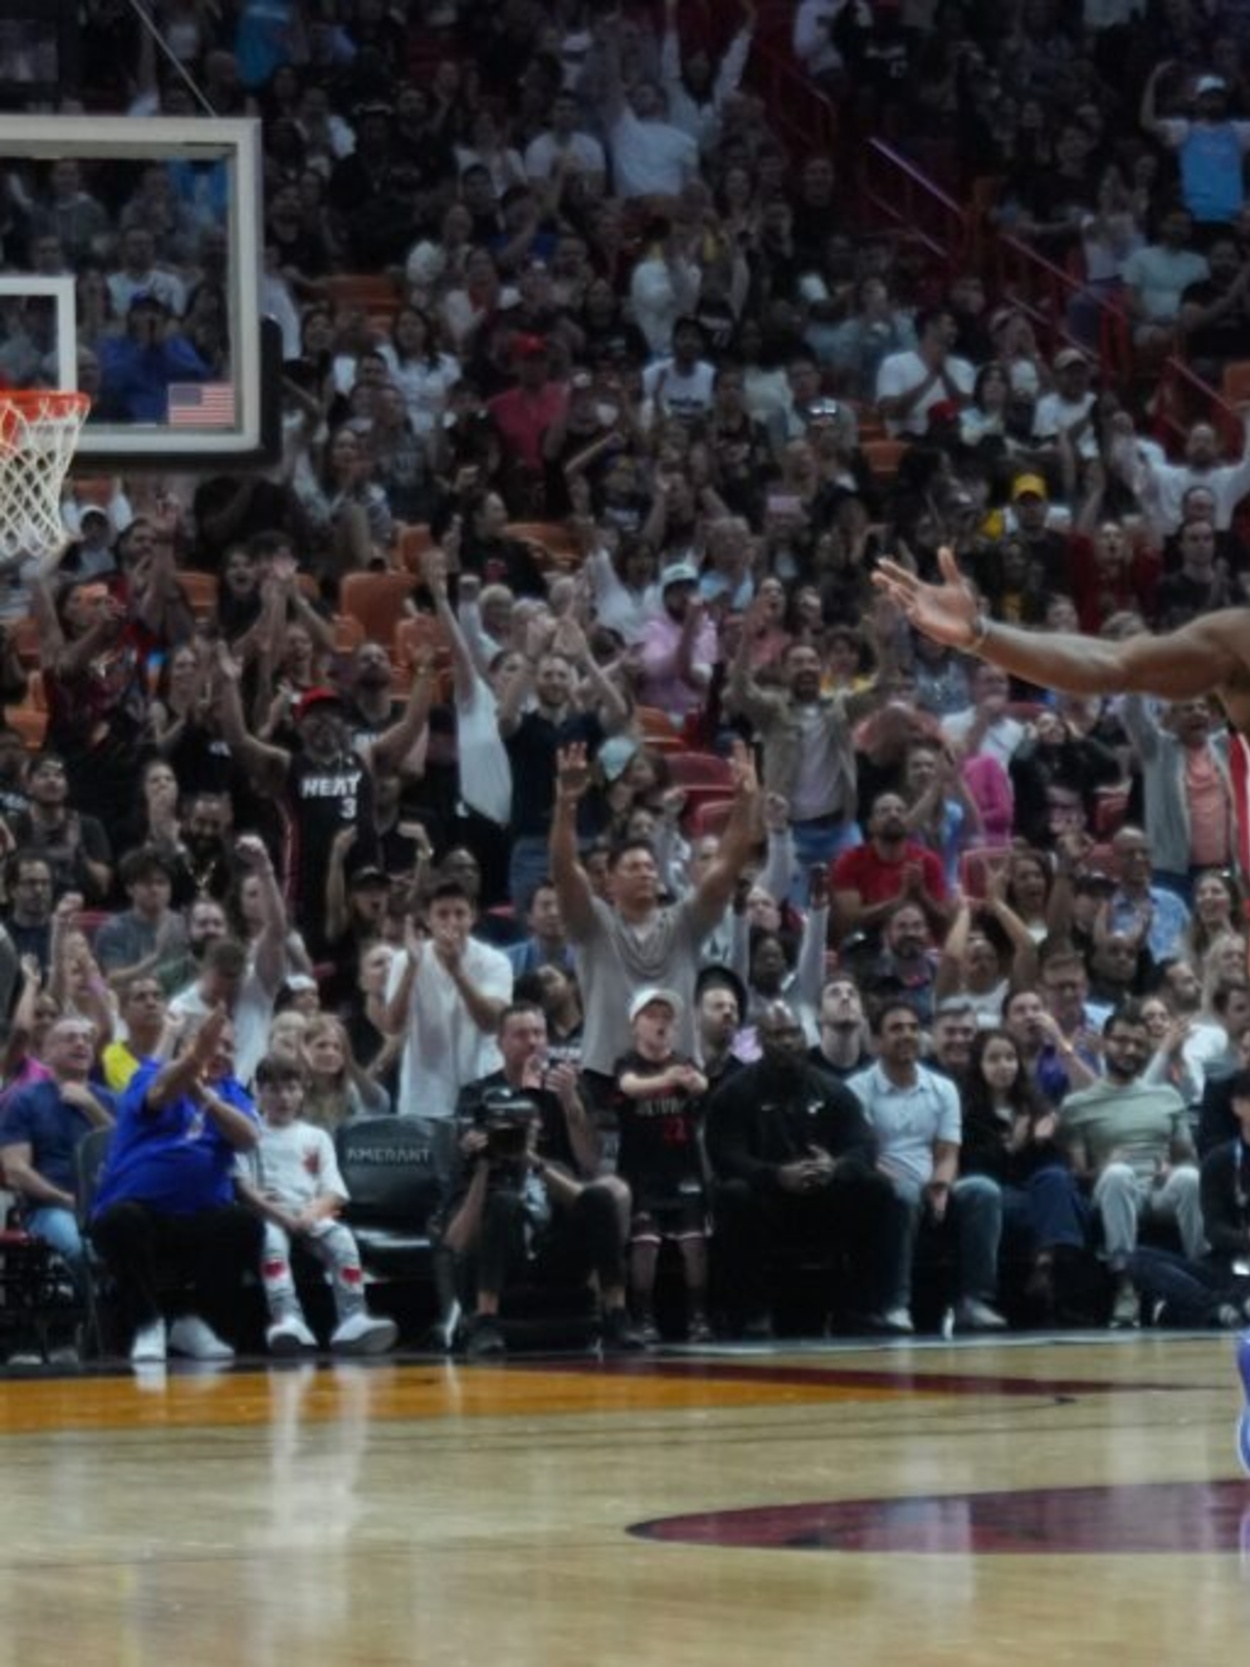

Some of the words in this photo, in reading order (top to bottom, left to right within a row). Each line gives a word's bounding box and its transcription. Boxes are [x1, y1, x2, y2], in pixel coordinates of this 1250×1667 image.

[301, 771, 363, 799] HEAT
[340, 798, 358, 819] 3
[346, 1147, 431, 1163] AMERANT
